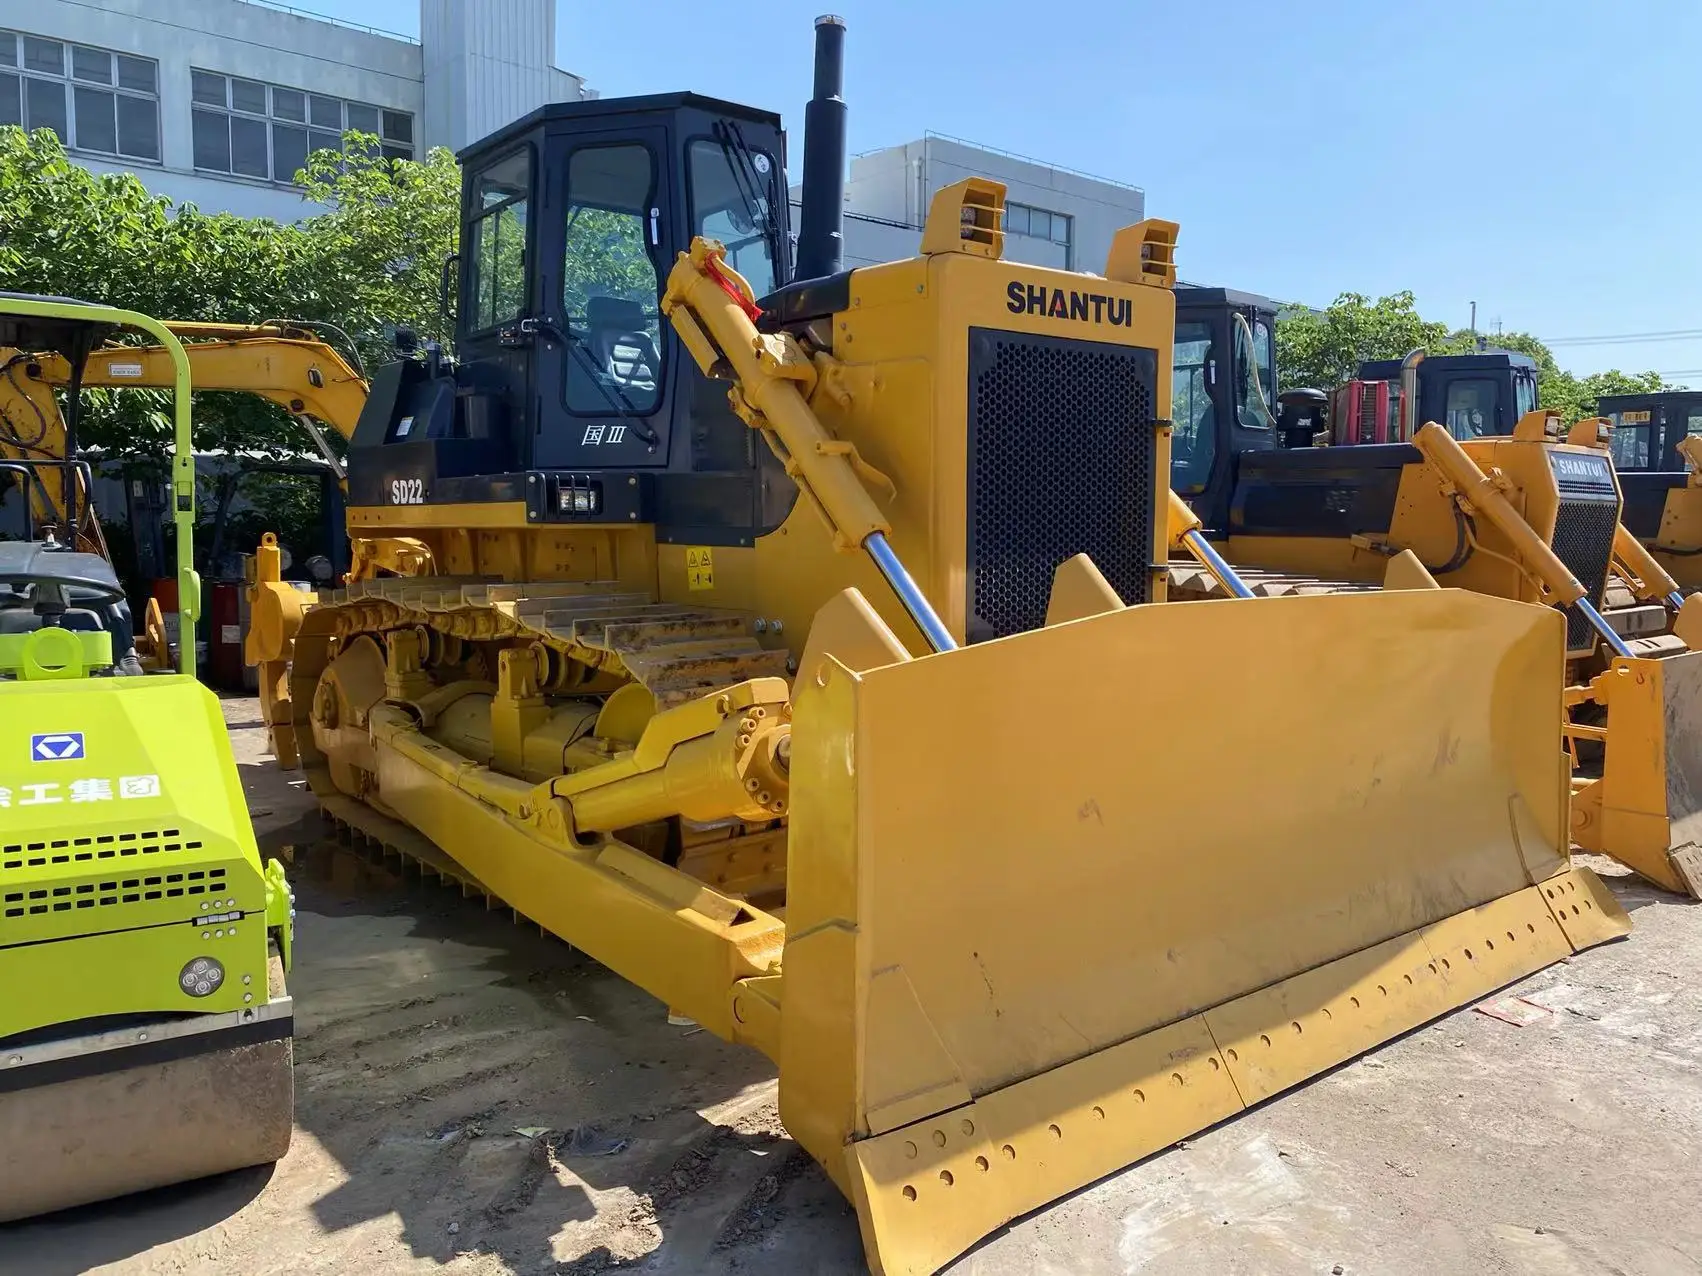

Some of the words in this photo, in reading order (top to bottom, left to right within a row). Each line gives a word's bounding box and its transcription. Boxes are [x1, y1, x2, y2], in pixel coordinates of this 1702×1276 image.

[1006, 281, 1132, 327] SHANTUI
[1559, 459, 1603, 477] SHANTUI
[392, 479, 423, 504] SD22
